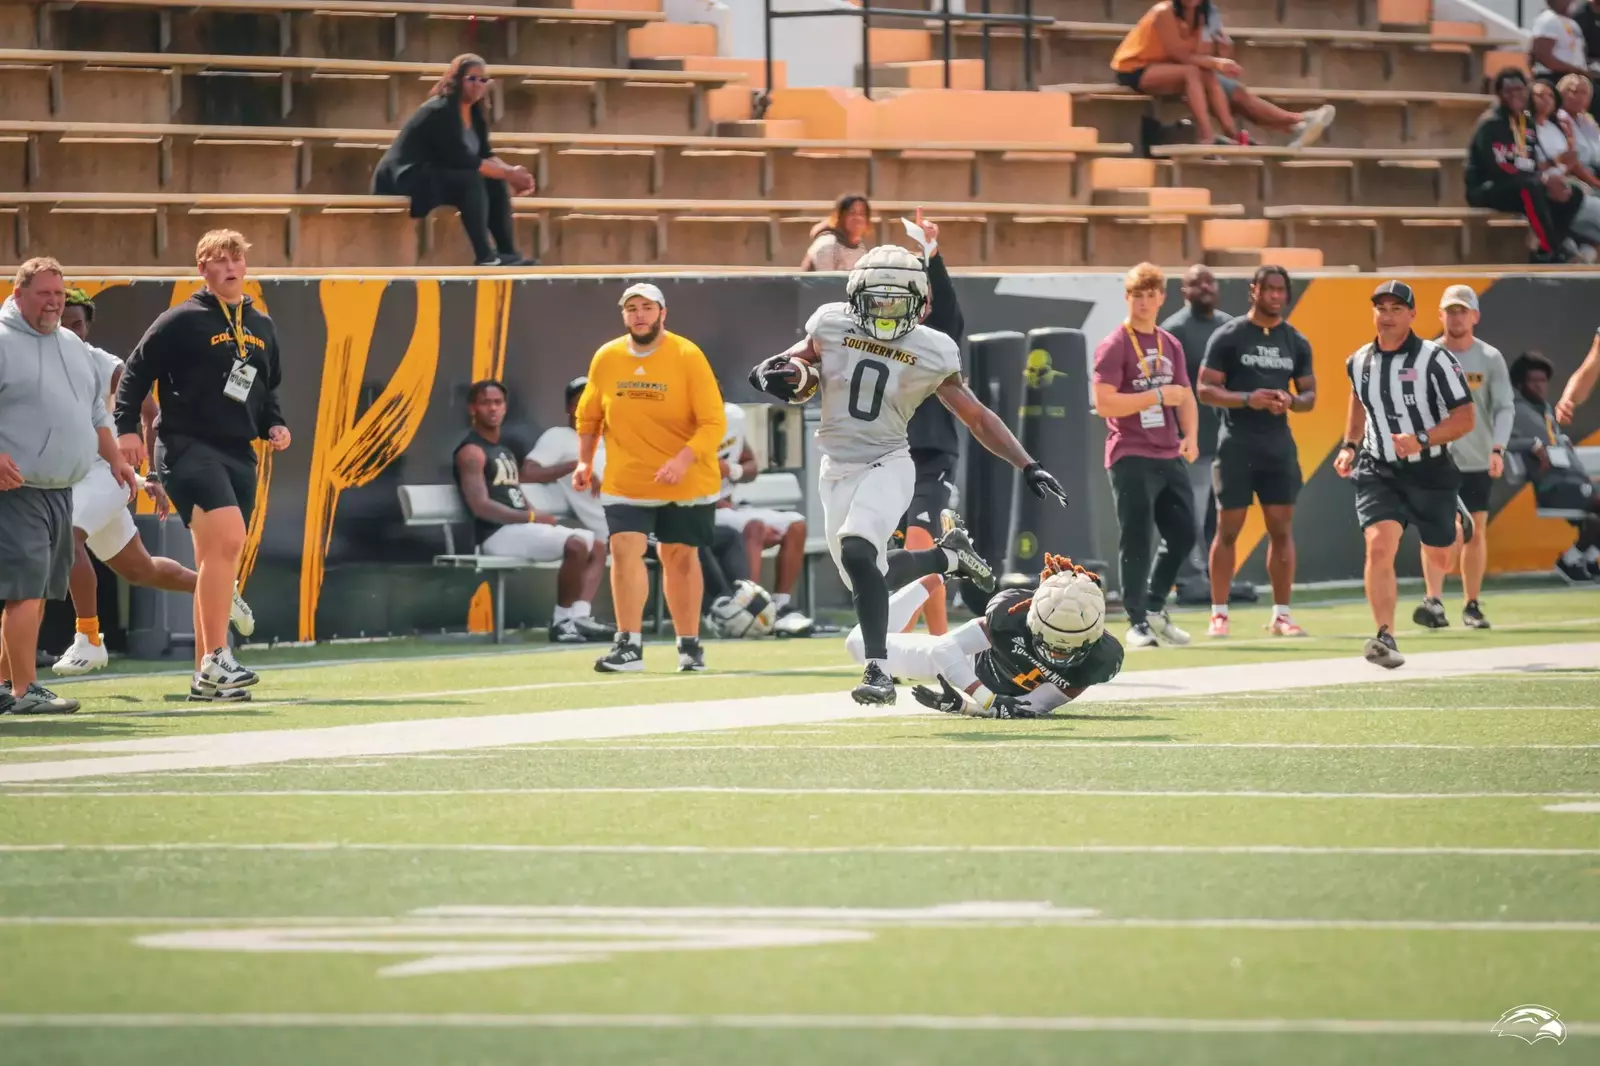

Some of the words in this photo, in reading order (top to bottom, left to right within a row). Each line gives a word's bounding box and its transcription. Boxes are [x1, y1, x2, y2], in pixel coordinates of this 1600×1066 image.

[211, 333, 265, 350] COLMBIA
[842, 336, 894, 360] SOUTHERN
[892, 350, 918, 366] MISS
[1256, 345, 1279, 357] THE
[848, 358, 890, 422] 0
[1403, 394, 1415, 405] H
[1049, 671, 1071, 690] MISS
